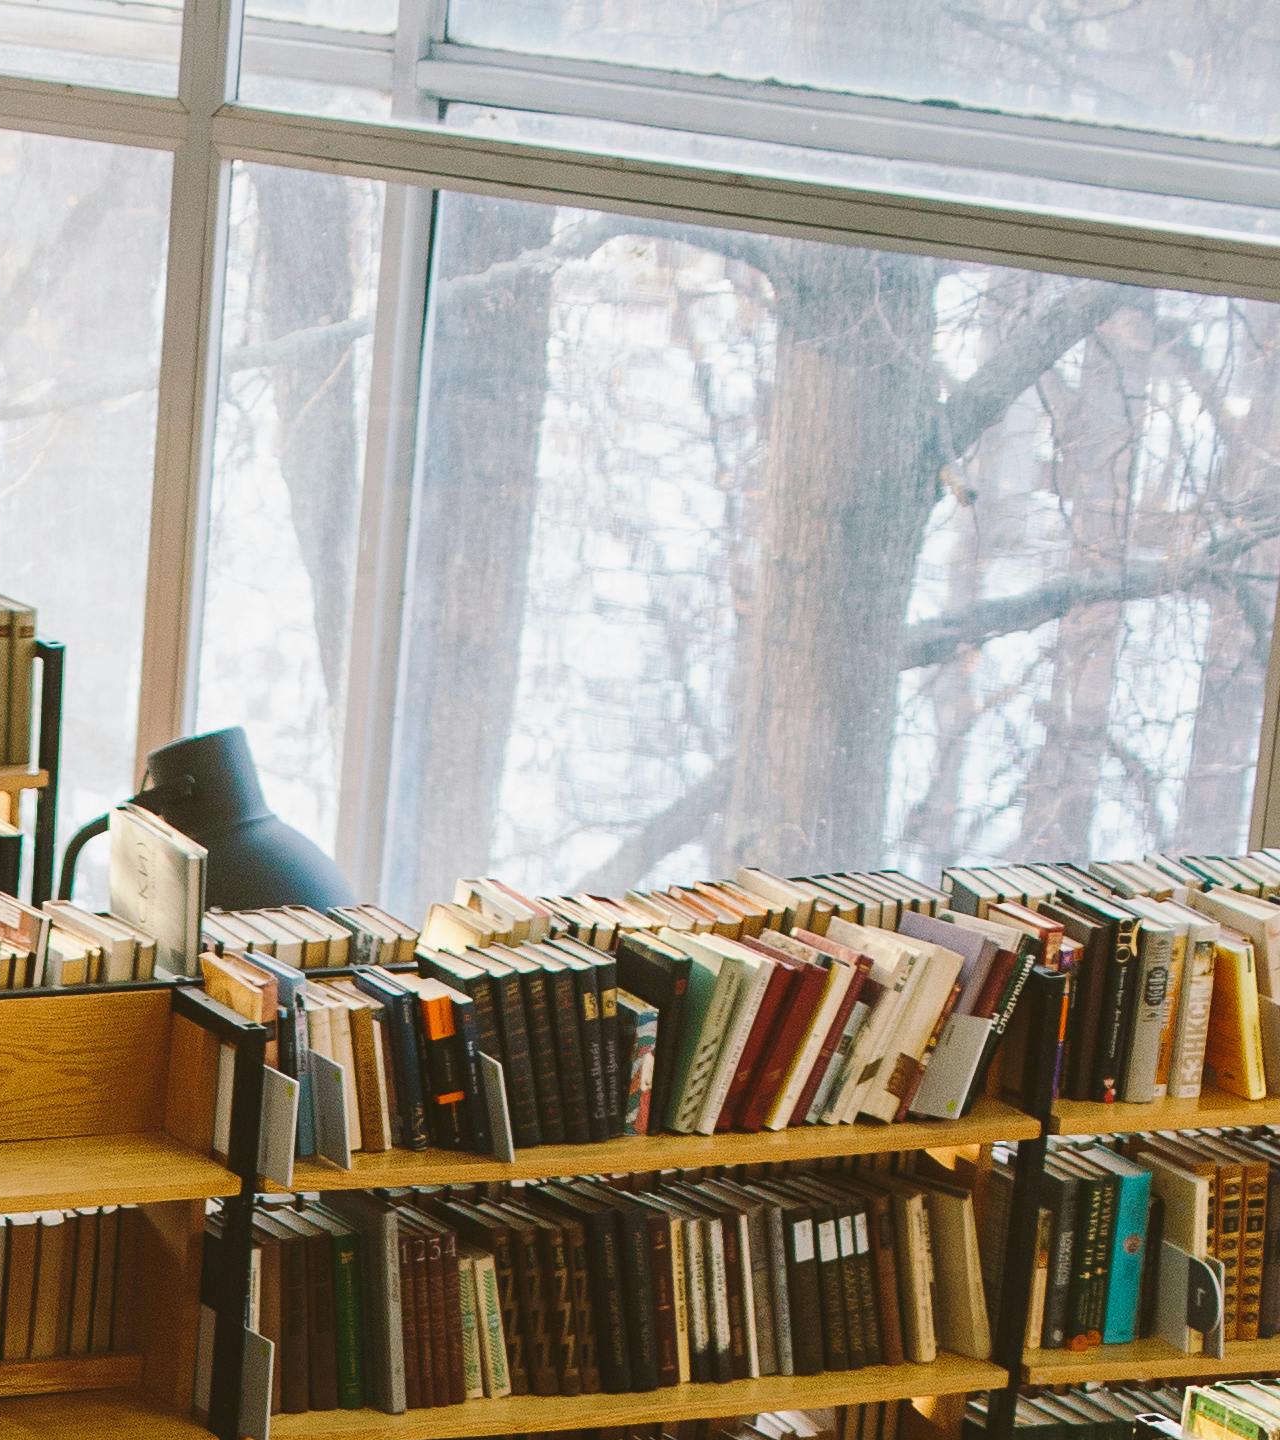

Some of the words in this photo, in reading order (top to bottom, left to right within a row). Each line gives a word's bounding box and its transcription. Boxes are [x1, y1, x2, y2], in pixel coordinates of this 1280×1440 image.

[995, 954, 1036, 1036] СЛЕДУЮЩИЙ
[401, 1241, 409, 1264] 1
[414, 1240, 426, 1261] 2
[429, 1238, 441, 1261] 3
[443, 1236, 457, 1257] 4
